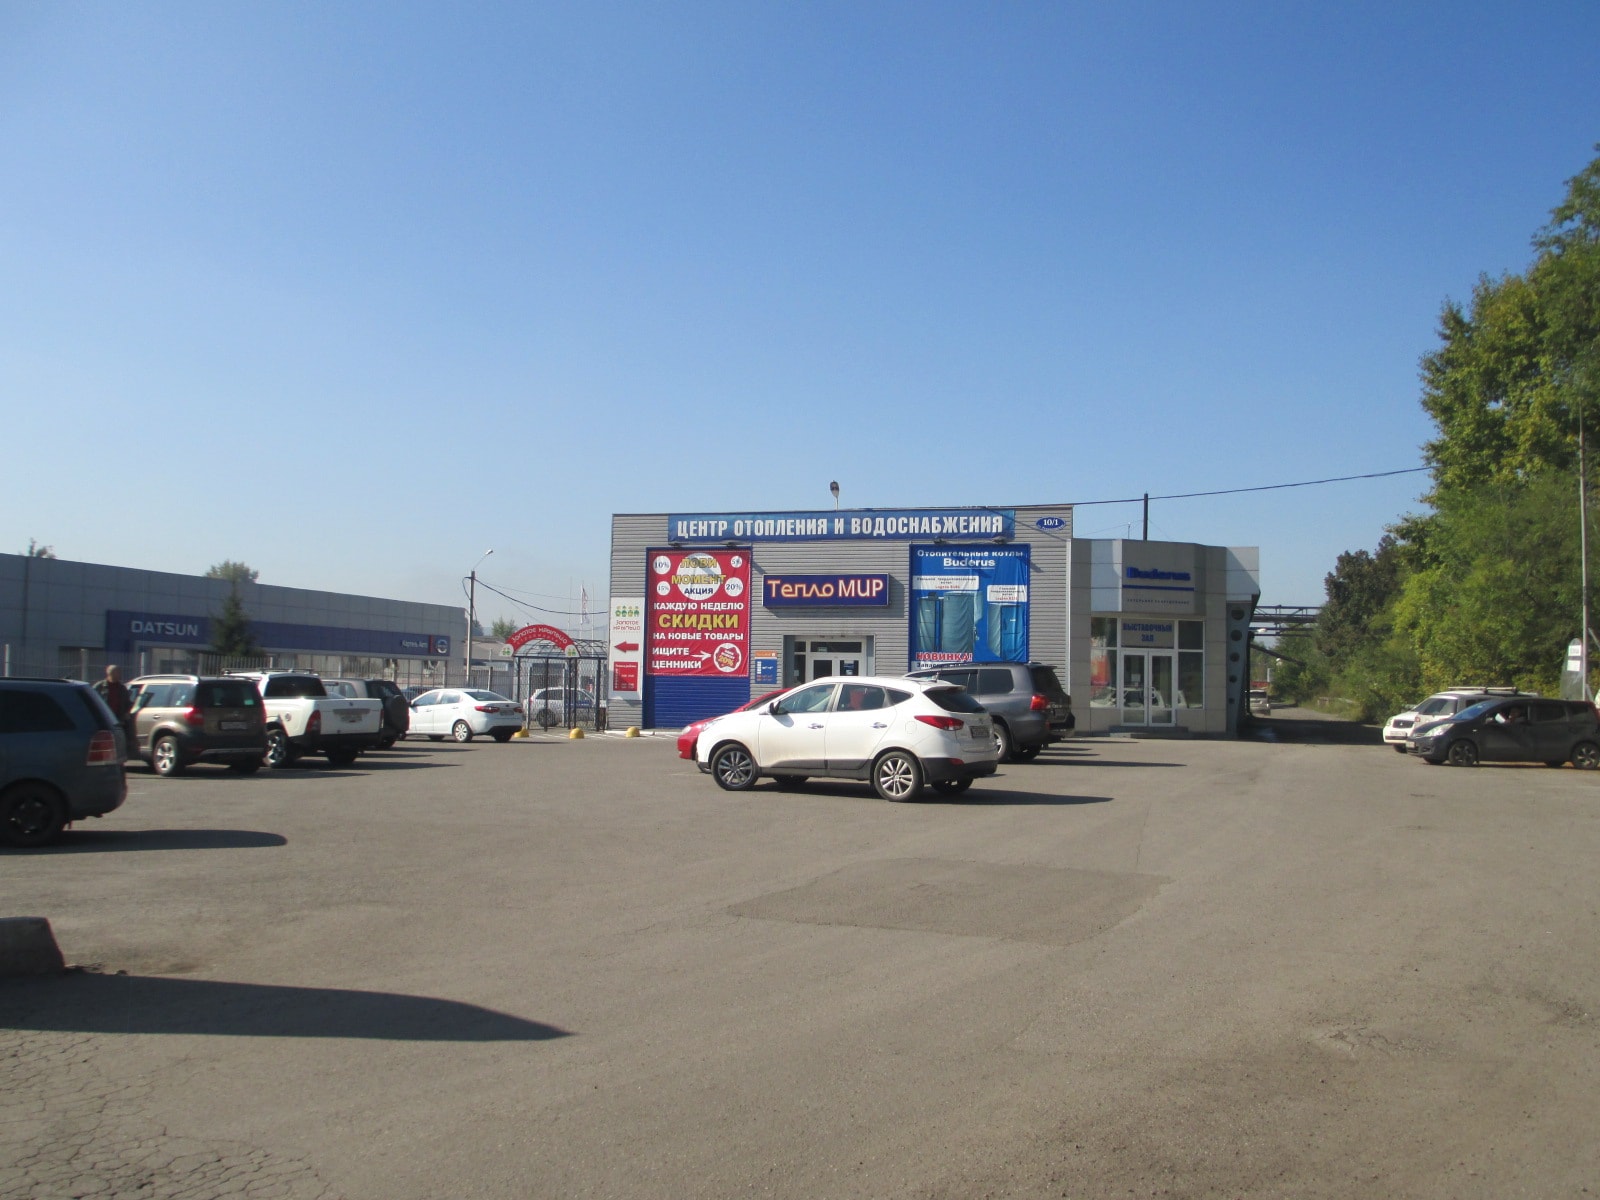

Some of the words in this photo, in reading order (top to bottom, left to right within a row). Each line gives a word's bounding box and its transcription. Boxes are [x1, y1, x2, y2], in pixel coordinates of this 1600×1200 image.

[677, 520, 728, 538] ЦЕНТР
[733, 518, 829, 537] ОТОПЛЕНИЯ
[834, 517, 845, 535] И
[850, 514, 1003, 535] ВОДОСНАБЖЕНИЯ
[1043, 518, 1059, 526] 10/1
[917, 549, 989, 557] Отопительные
[680, 557, 718, 569] ЛОВИ
[943, 558, 996, 567] Buderus
[671, 574, 727, 585] МОМЕНТ
[684, 587, 714, 595] АКЦИЯ
[725, 583, 743, 591] 20%
[767, 579, 834, 598] Тепло
[653, 602, 698, 611] КАЖДУЮ
[700, 602, 744, 611] НЕДЕЛЮ
[658, 613, 739, 631] СКИДКИ
[131, 620, 198, 636] DATSUN
[668, 632, 702, 640] НОВЫЕ
[704, 632, 744, 640] ТОВАРЫ
[652, 647, 690, 656] ИЩИТЕ
[916, 652, 973, 662] НОВИНКА!
[651, 660, 702, 669] ЦЕННИКИ
